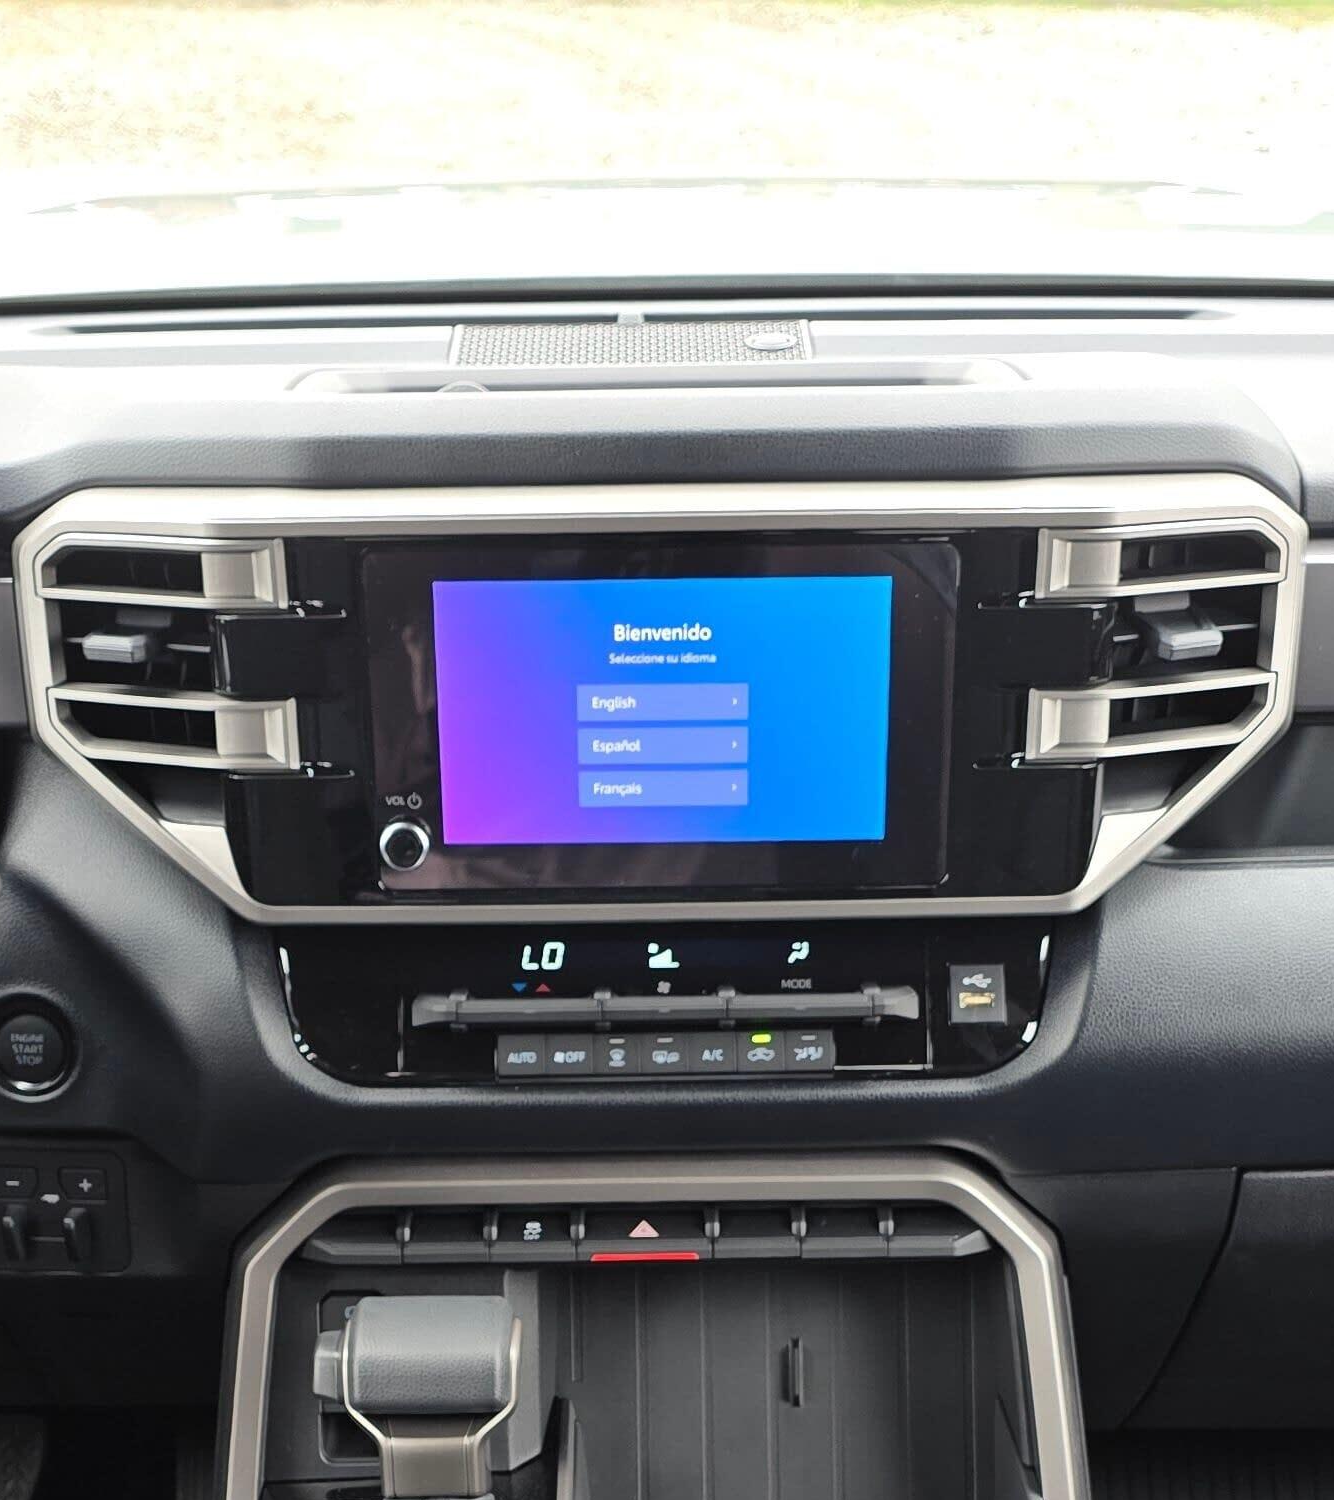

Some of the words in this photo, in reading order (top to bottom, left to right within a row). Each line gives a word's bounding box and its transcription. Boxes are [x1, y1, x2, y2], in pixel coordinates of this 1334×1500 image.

[613, 622, 712, 642] Bienvenido
[609, 652, 665, 665] Seleccione
[666, 654, 679, 664] su
[680, 652, 717, 664] idioma
[591, 696, 637, 713] English
[592, 739, 641, 754] Español
[593, 782, 643, 797] Français
[385, 795, 406, 806] VOL
[521, 941, 565, 971] LO
[780, 978, 813, 989] MODE
[11, 1043, 44, 1054] START
[701, 1048, 724, 1062] A/C
[15, 1054, 44, 1066] STOP
[507, 1051, 538, 1064] AUTO
[565, 1050, 586, 1064] OFF
